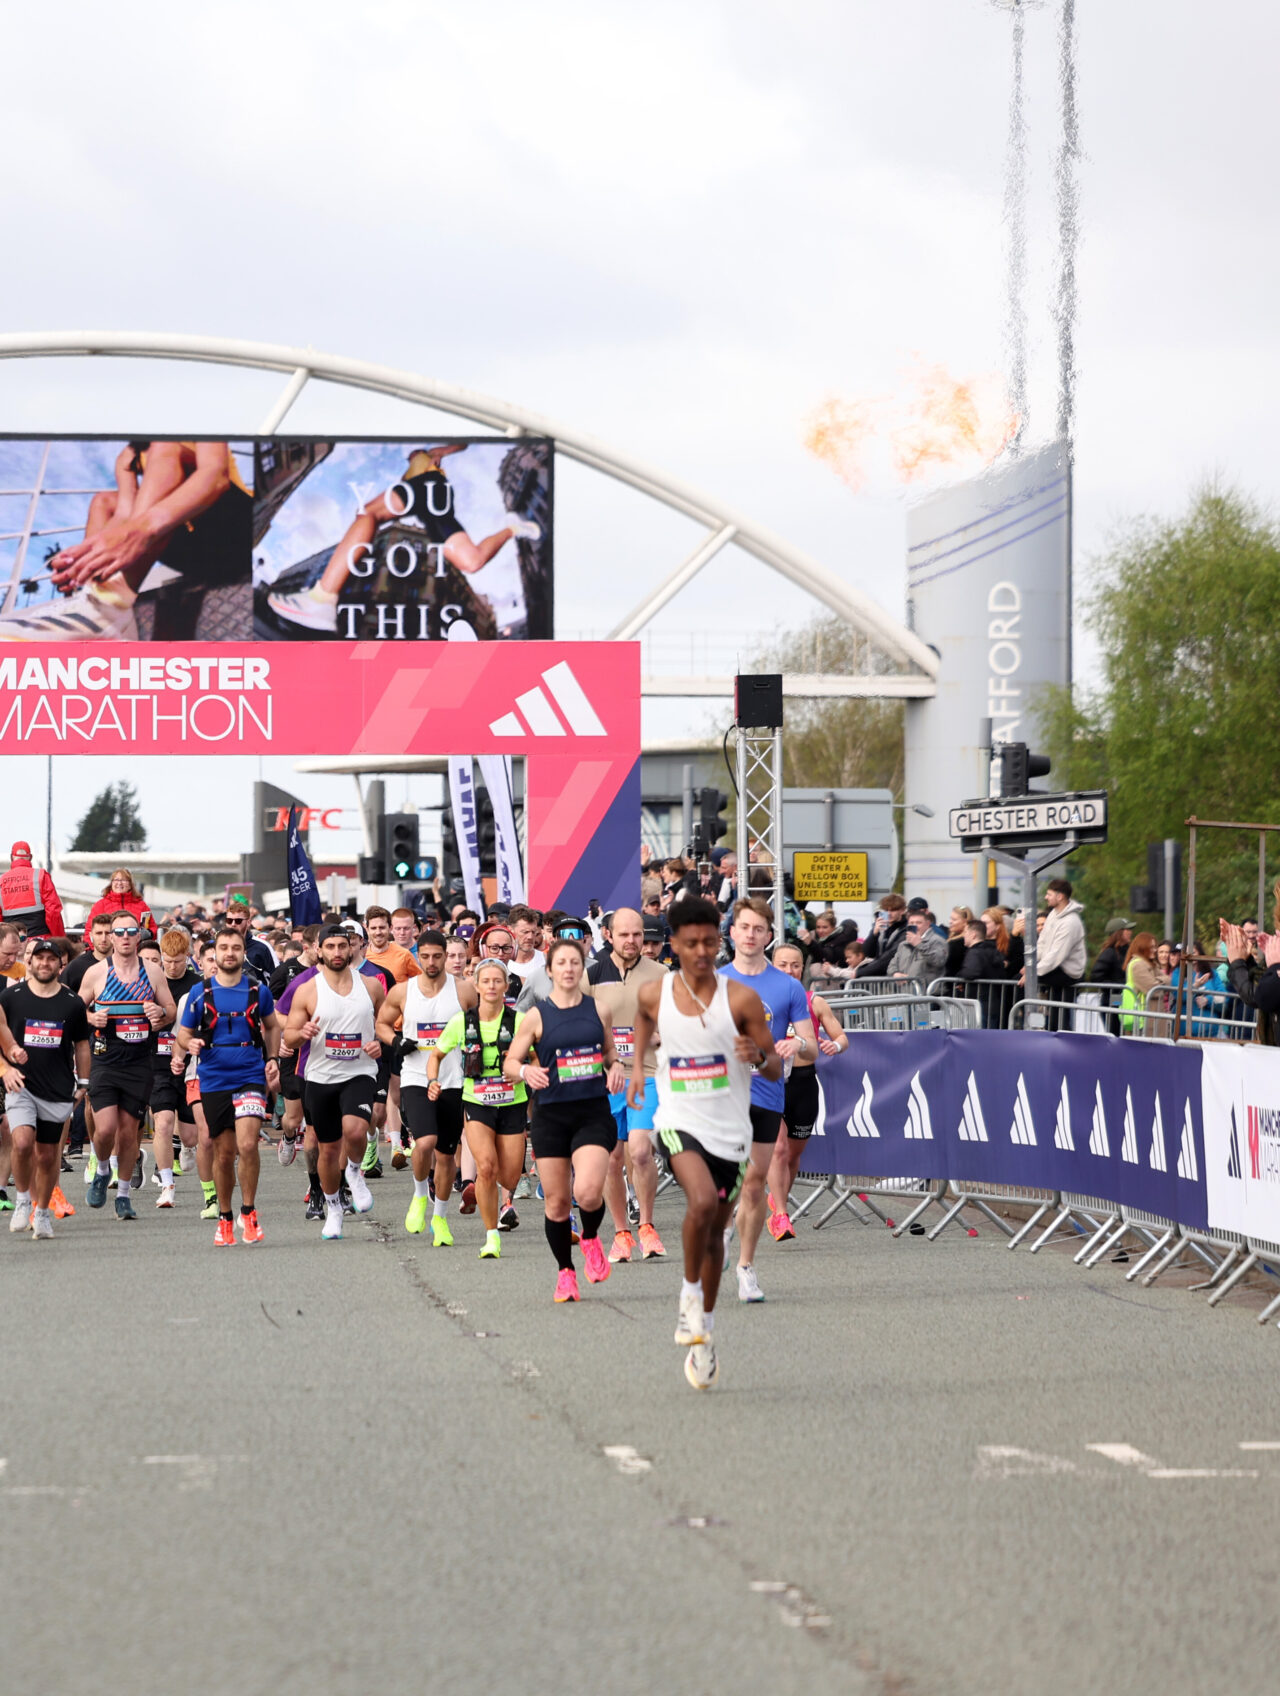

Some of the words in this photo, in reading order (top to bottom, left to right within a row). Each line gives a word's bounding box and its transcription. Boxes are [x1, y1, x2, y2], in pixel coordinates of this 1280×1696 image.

[346, 480, 453, 517] YOU
[346, 542, 454, 578] GOT
[337, 603, 464, 640] THIS
[987, 580, 1022, 798] AFFORD
[273, 806, 343, 832] KFC
[955, 806, 1038, 833] CHESTER
[1046, 802, 1097, 827] ROAD
[812, 855, 827, 863] DO
[829, 855, 849, 863] NOT
[810, 864, 841, 872] ENTER
[2, 874, 30, 884] OFFICIAL
[2, 884, 30, 895] STARTER
[797, 881, 836, 889] UNLESS
[838, 881, 863, 889] YOUR
[797, 889, 817, 897] EXIT
[820, 889, 830, 897] IS
[832, 889, 863, 897] CLEAR
[331, 1048, 355, 1056] 22697
[483, 1092, 506, 1101] 21437
